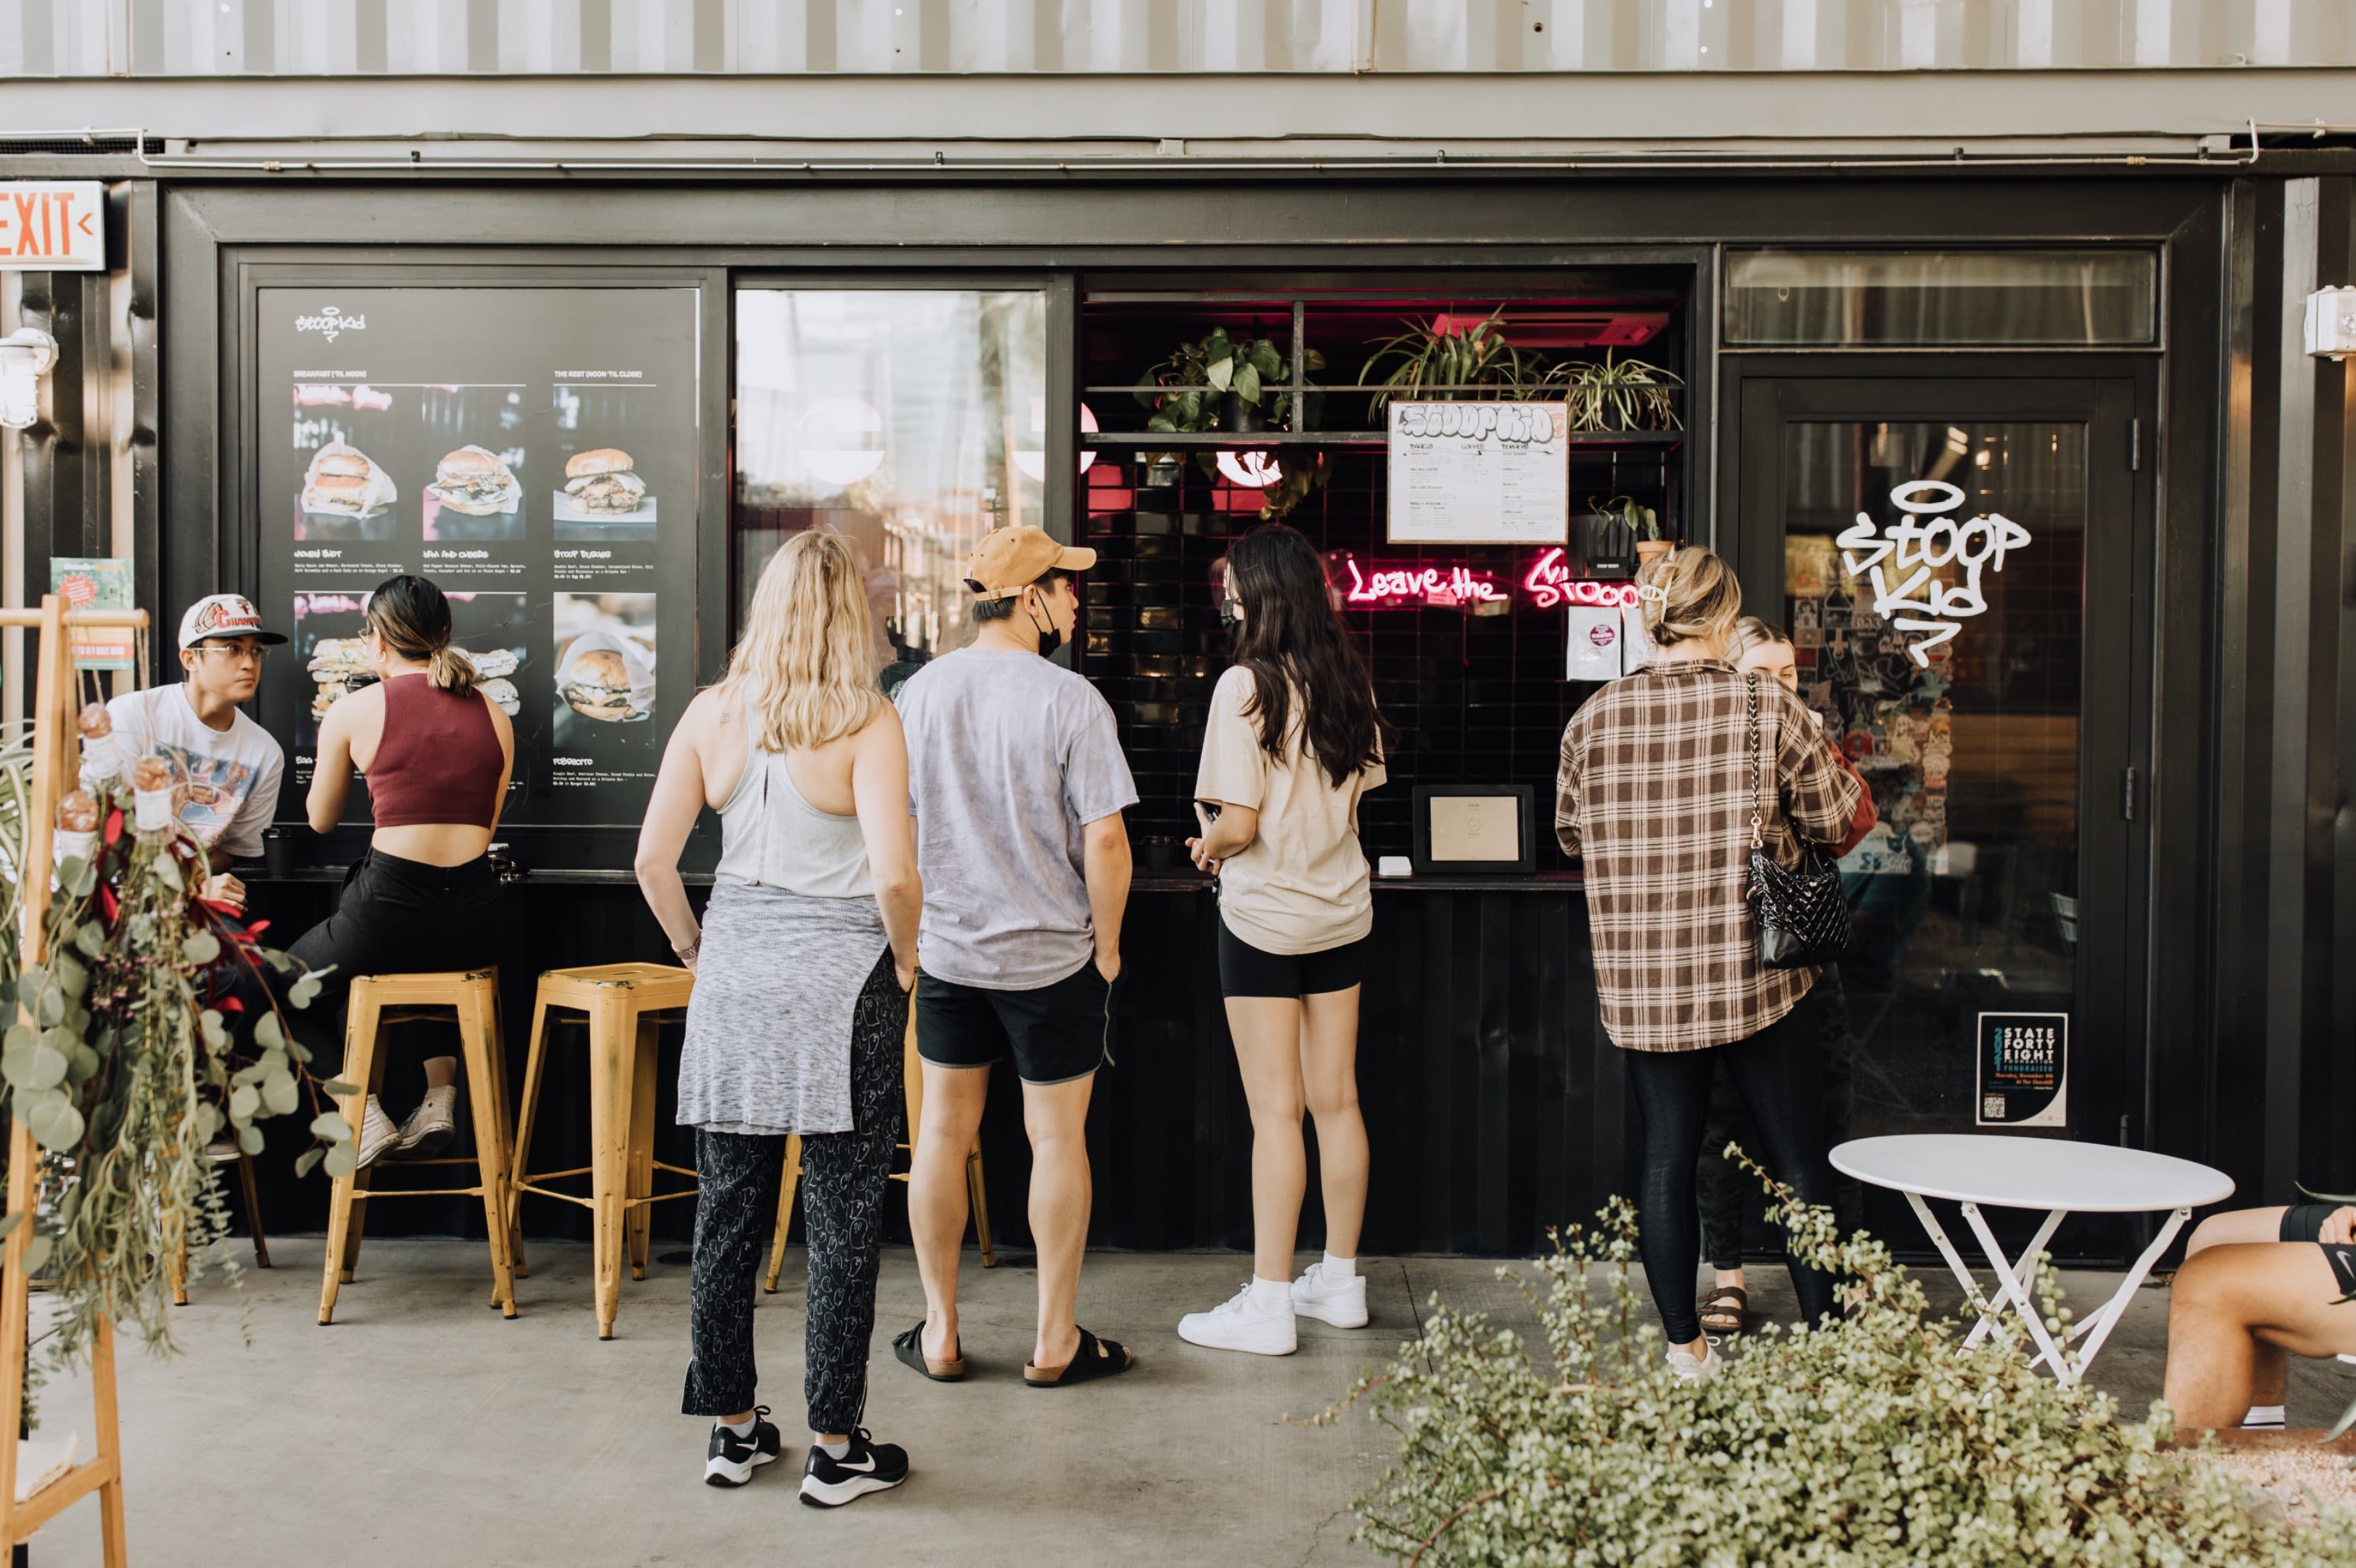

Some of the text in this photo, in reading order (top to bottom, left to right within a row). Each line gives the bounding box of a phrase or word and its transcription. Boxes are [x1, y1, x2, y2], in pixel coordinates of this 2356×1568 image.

[0, 192, 75, 256] EXIT
[293, 370, 331, 378] BREAKFAST
[1347, 559, 1448, 601] Leave
[1452, 566, 1508, 601] the
[2004, 1027, 2055, 1038] STATE
[2004, 1038, 2055, 1049] FORTY
[2004, 1049, 2054, 1060] EIGHT
